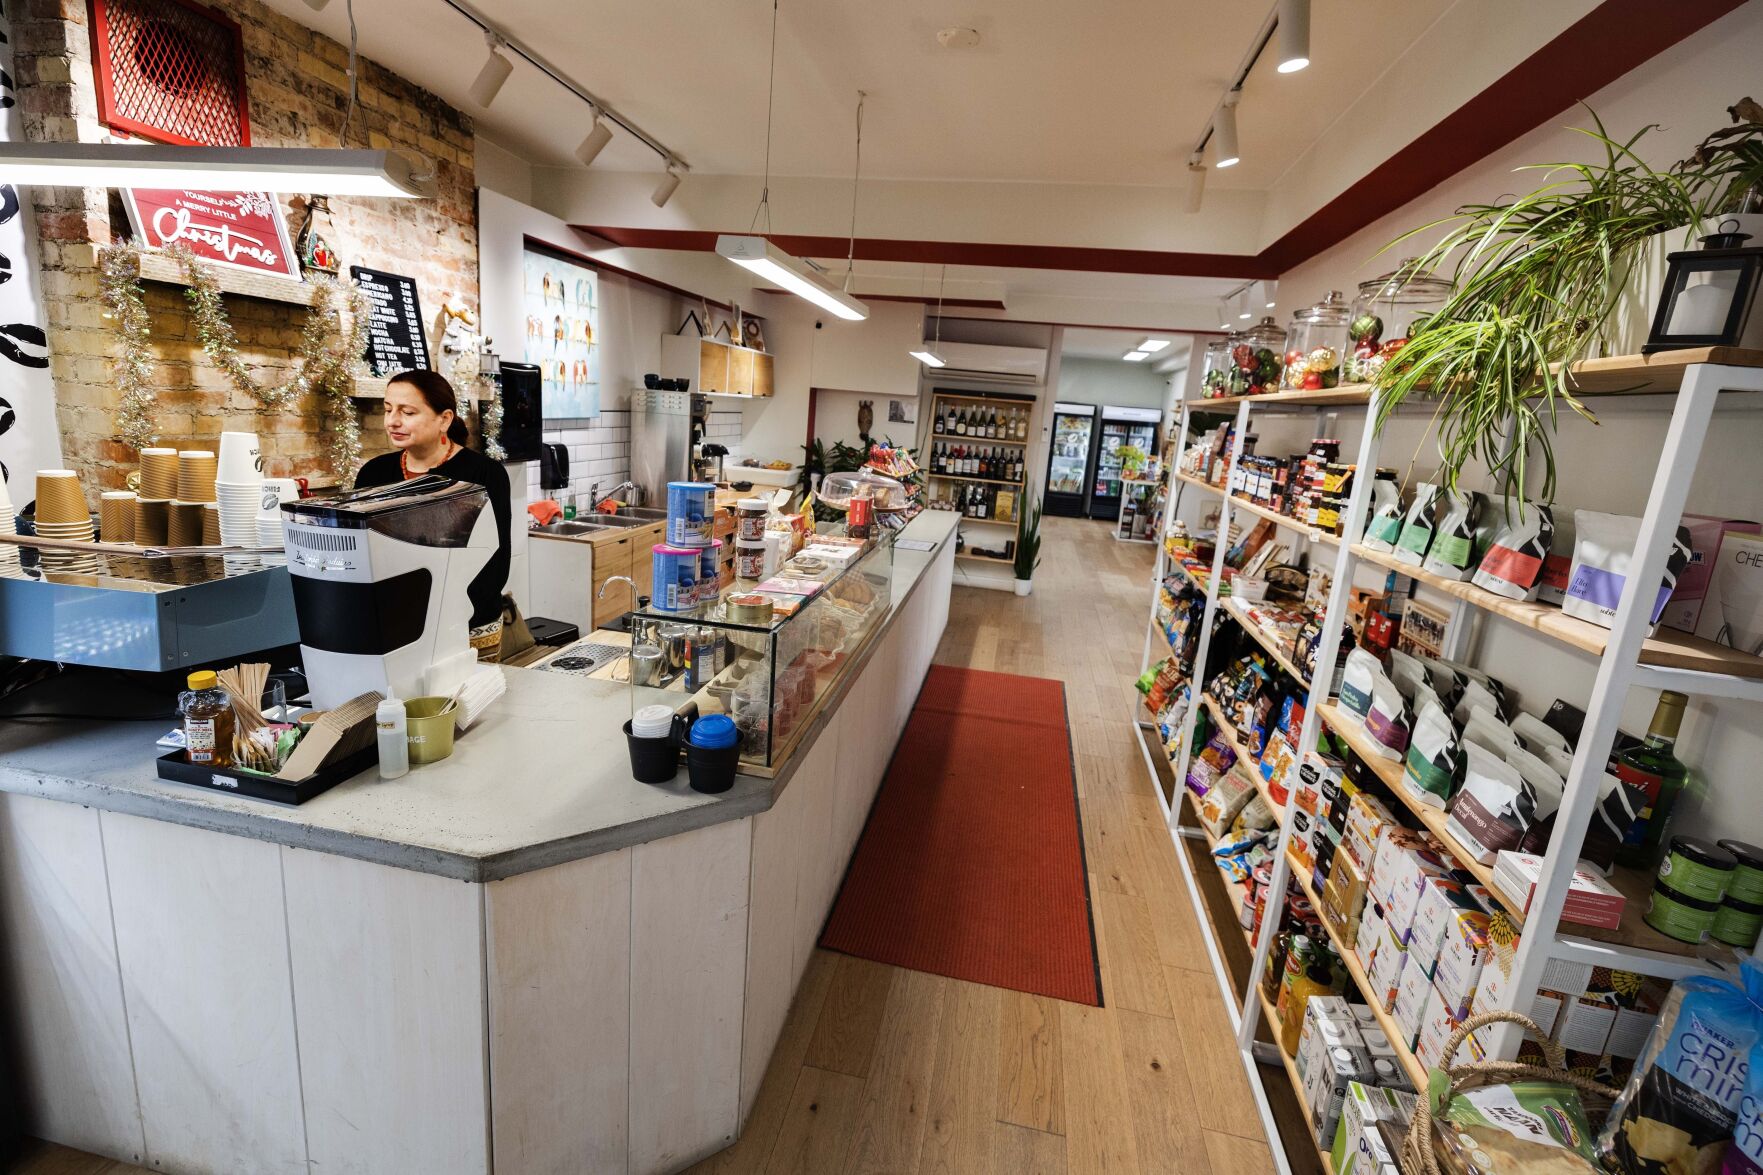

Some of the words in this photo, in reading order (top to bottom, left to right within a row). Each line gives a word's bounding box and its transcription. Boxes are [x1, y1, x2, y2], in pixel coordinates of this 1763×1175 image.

[183, 190, 224, 206] YOURSELF
[183, 202, 210, 213] MERRY
[212, 208, 237, 221] LITTLE
[153, 207, 277, 265] Christmas
[370, 320, 387, 329] LATTE
[373, 344, 384, 352] HOT
[384, 346, 410, 354] CHOCOLATE
[375, 352, 385, 360] HOT
[1493, 1107, 1543, 1135] NAAN
